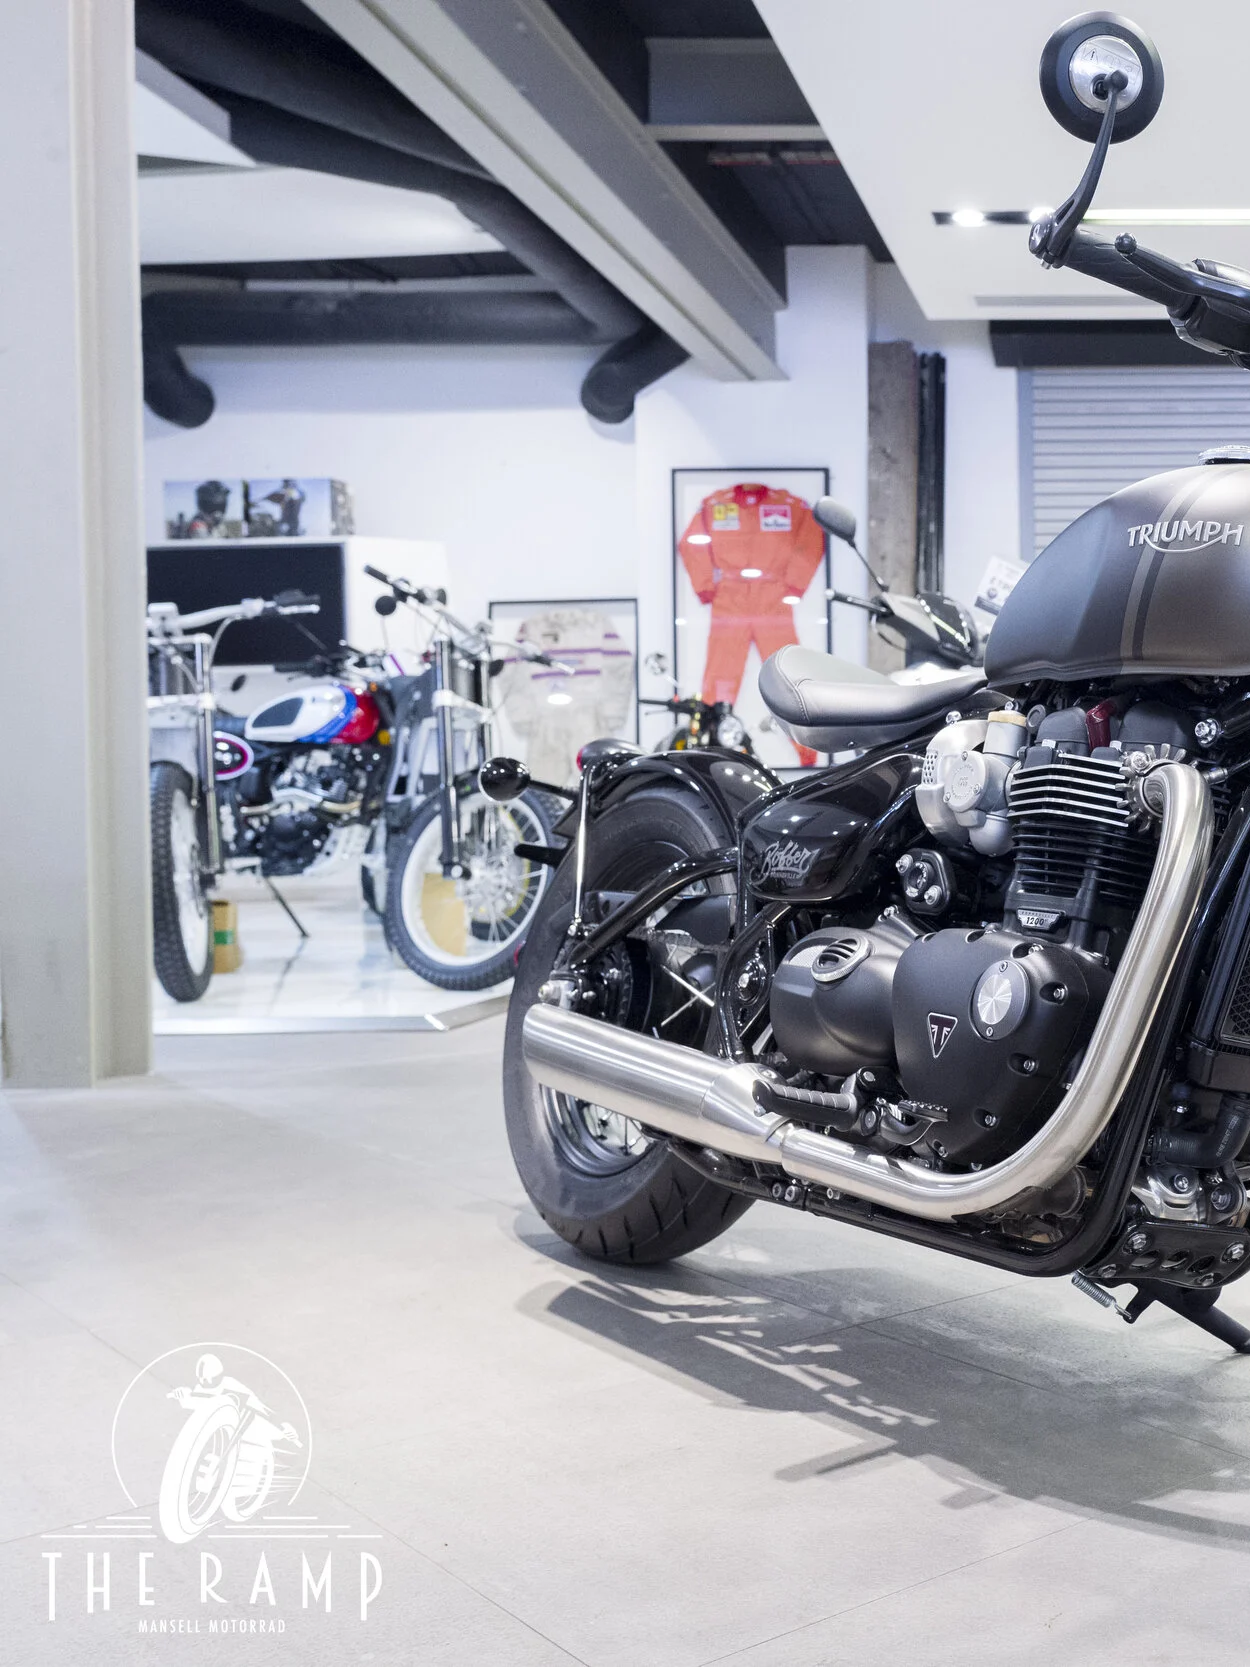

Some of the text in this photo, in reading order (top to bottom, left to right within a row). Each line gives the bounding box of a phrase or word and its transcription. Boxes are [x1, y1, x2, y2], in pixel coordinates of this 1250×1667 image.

[1127, 520, 1244, 553] TRIUMPH
[753, 840, 819, 883] Bobber
[1026, 916, 1045, 926] 1200
